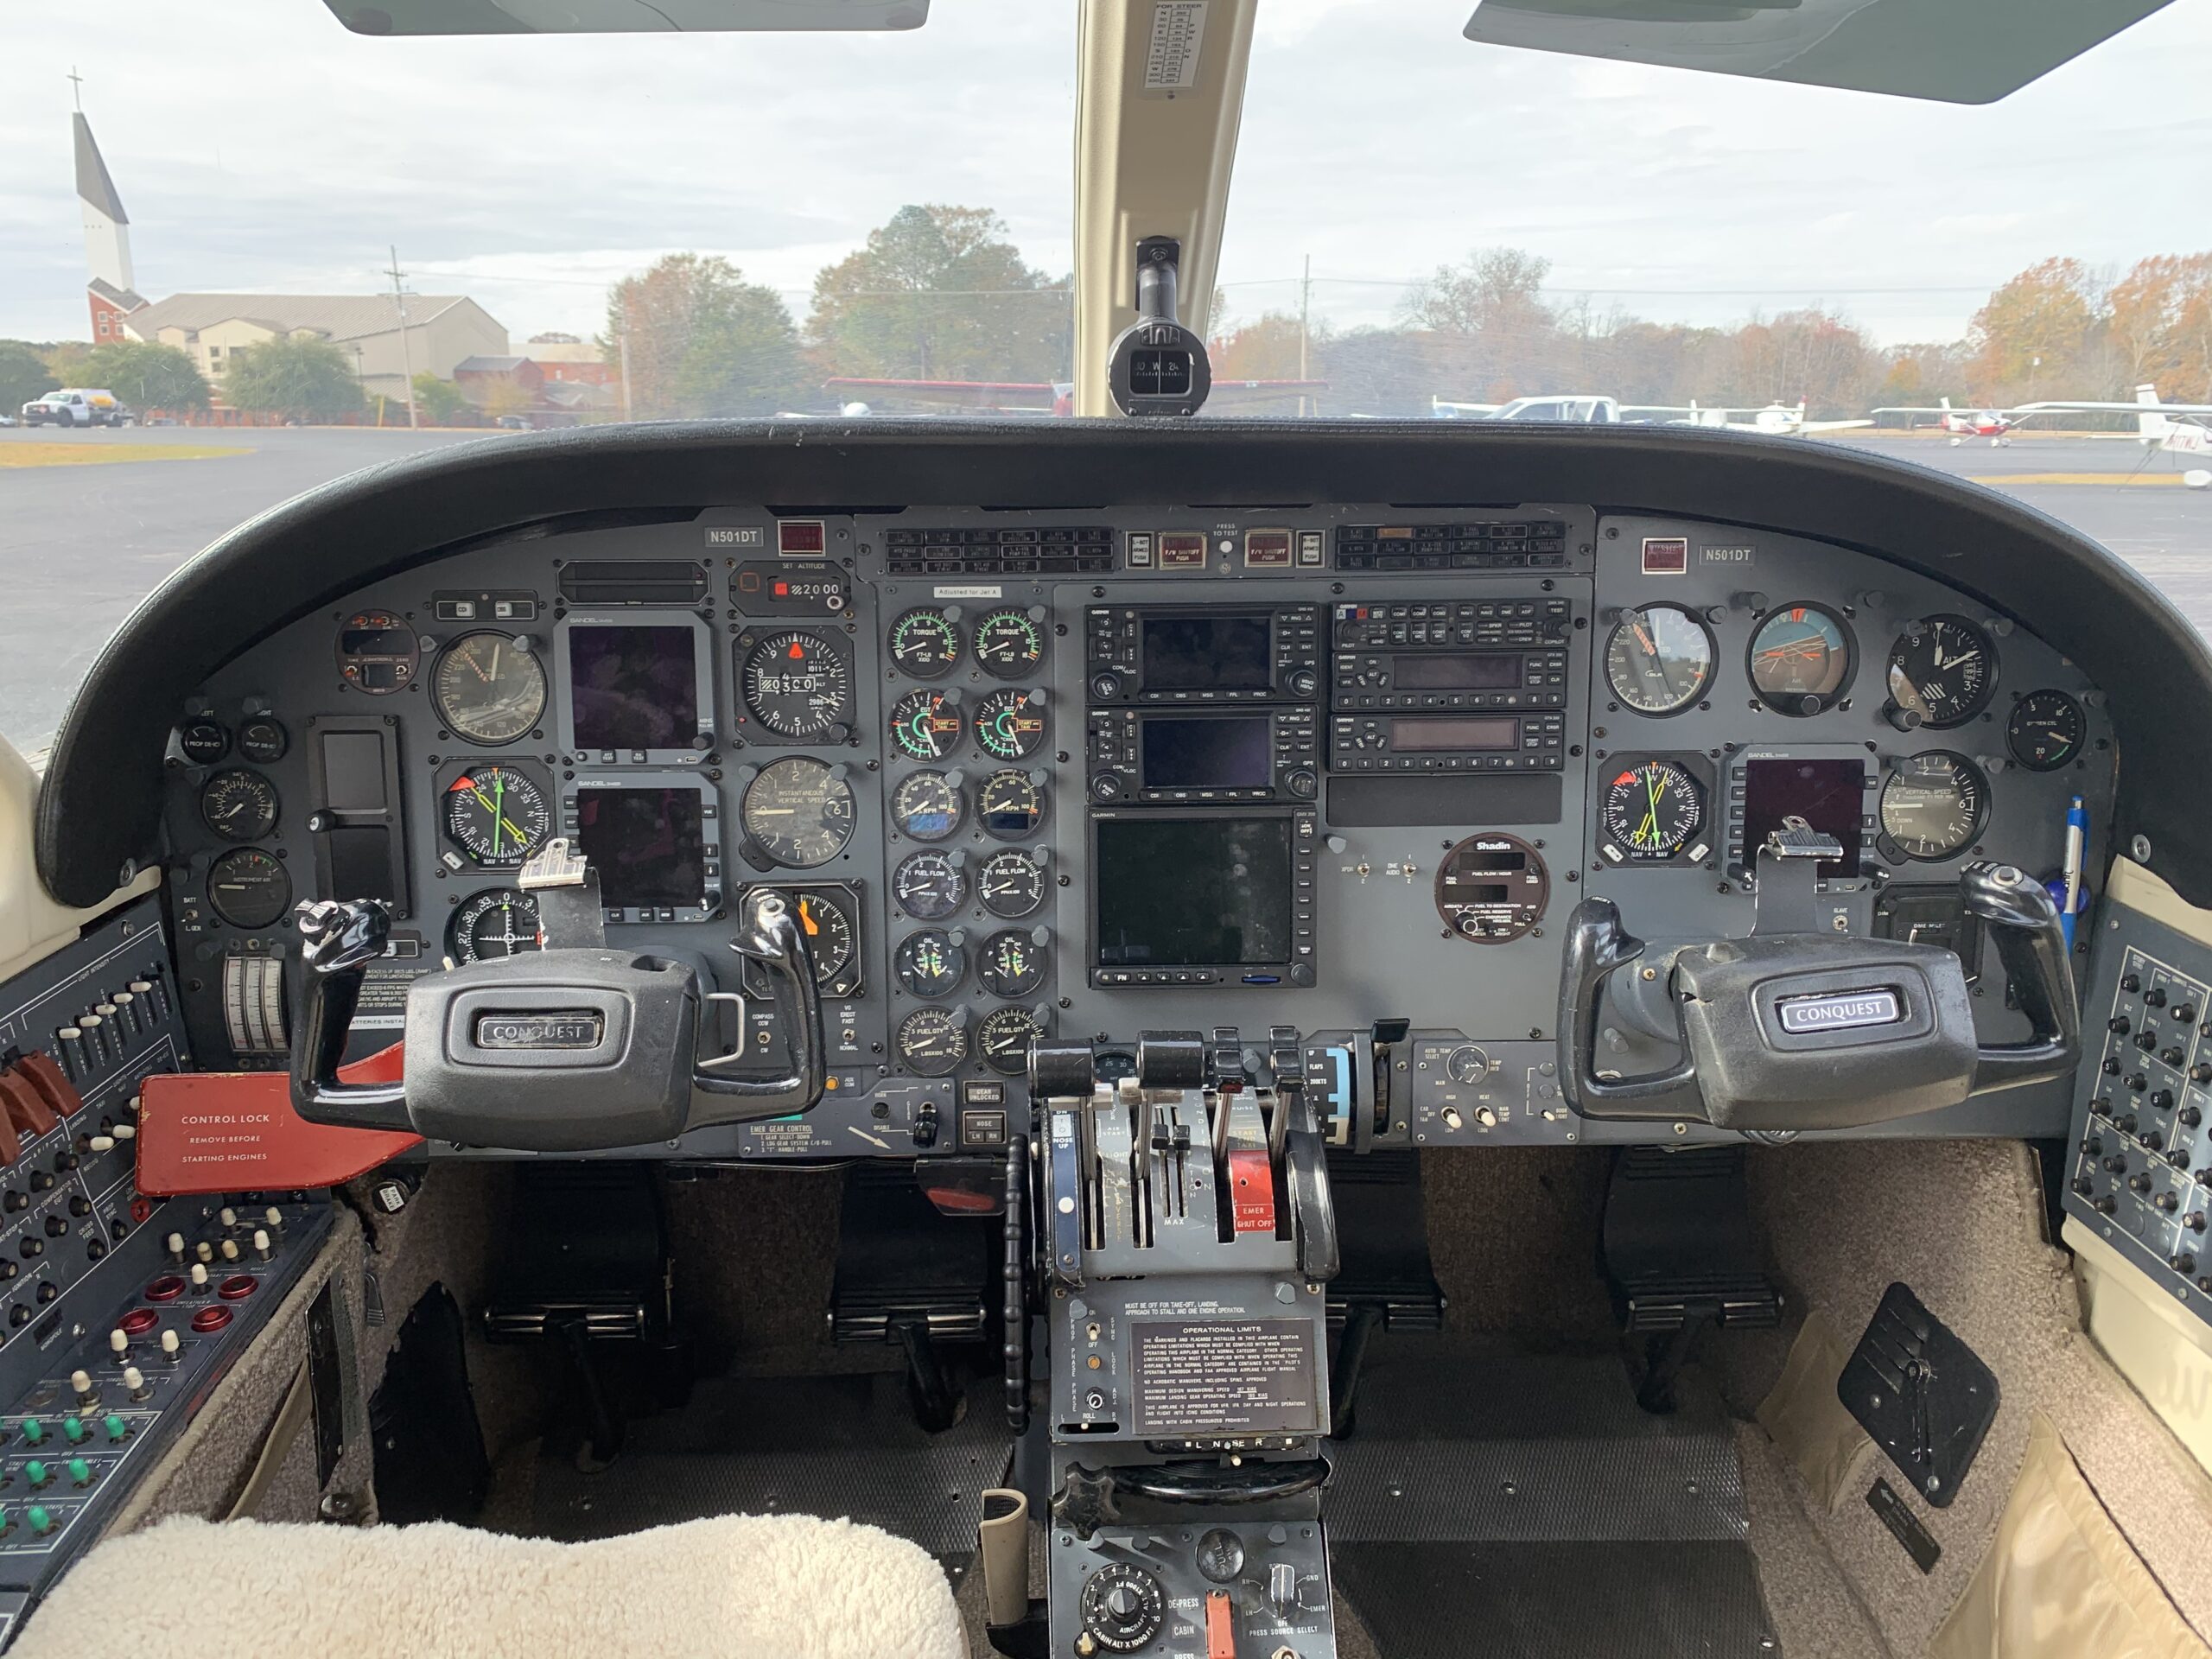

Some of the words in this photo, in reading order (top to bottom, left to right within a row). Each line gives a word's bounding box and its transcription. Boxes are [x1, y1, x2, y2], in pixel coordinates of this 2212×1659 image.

[710, 531, 758, 543] N501DT
[1706, 550, 1751, 561] N501DT
[1477, 842, 1510, 850] Shadin
[1796, 1001, 1882, 1021] CONQUEST
[493, 1026, 584, 1039] CONQUEST
[1168, 1599, 1198, 1609] DE-PRESS
[1174, 1626, 1194, 1636] CABIN
